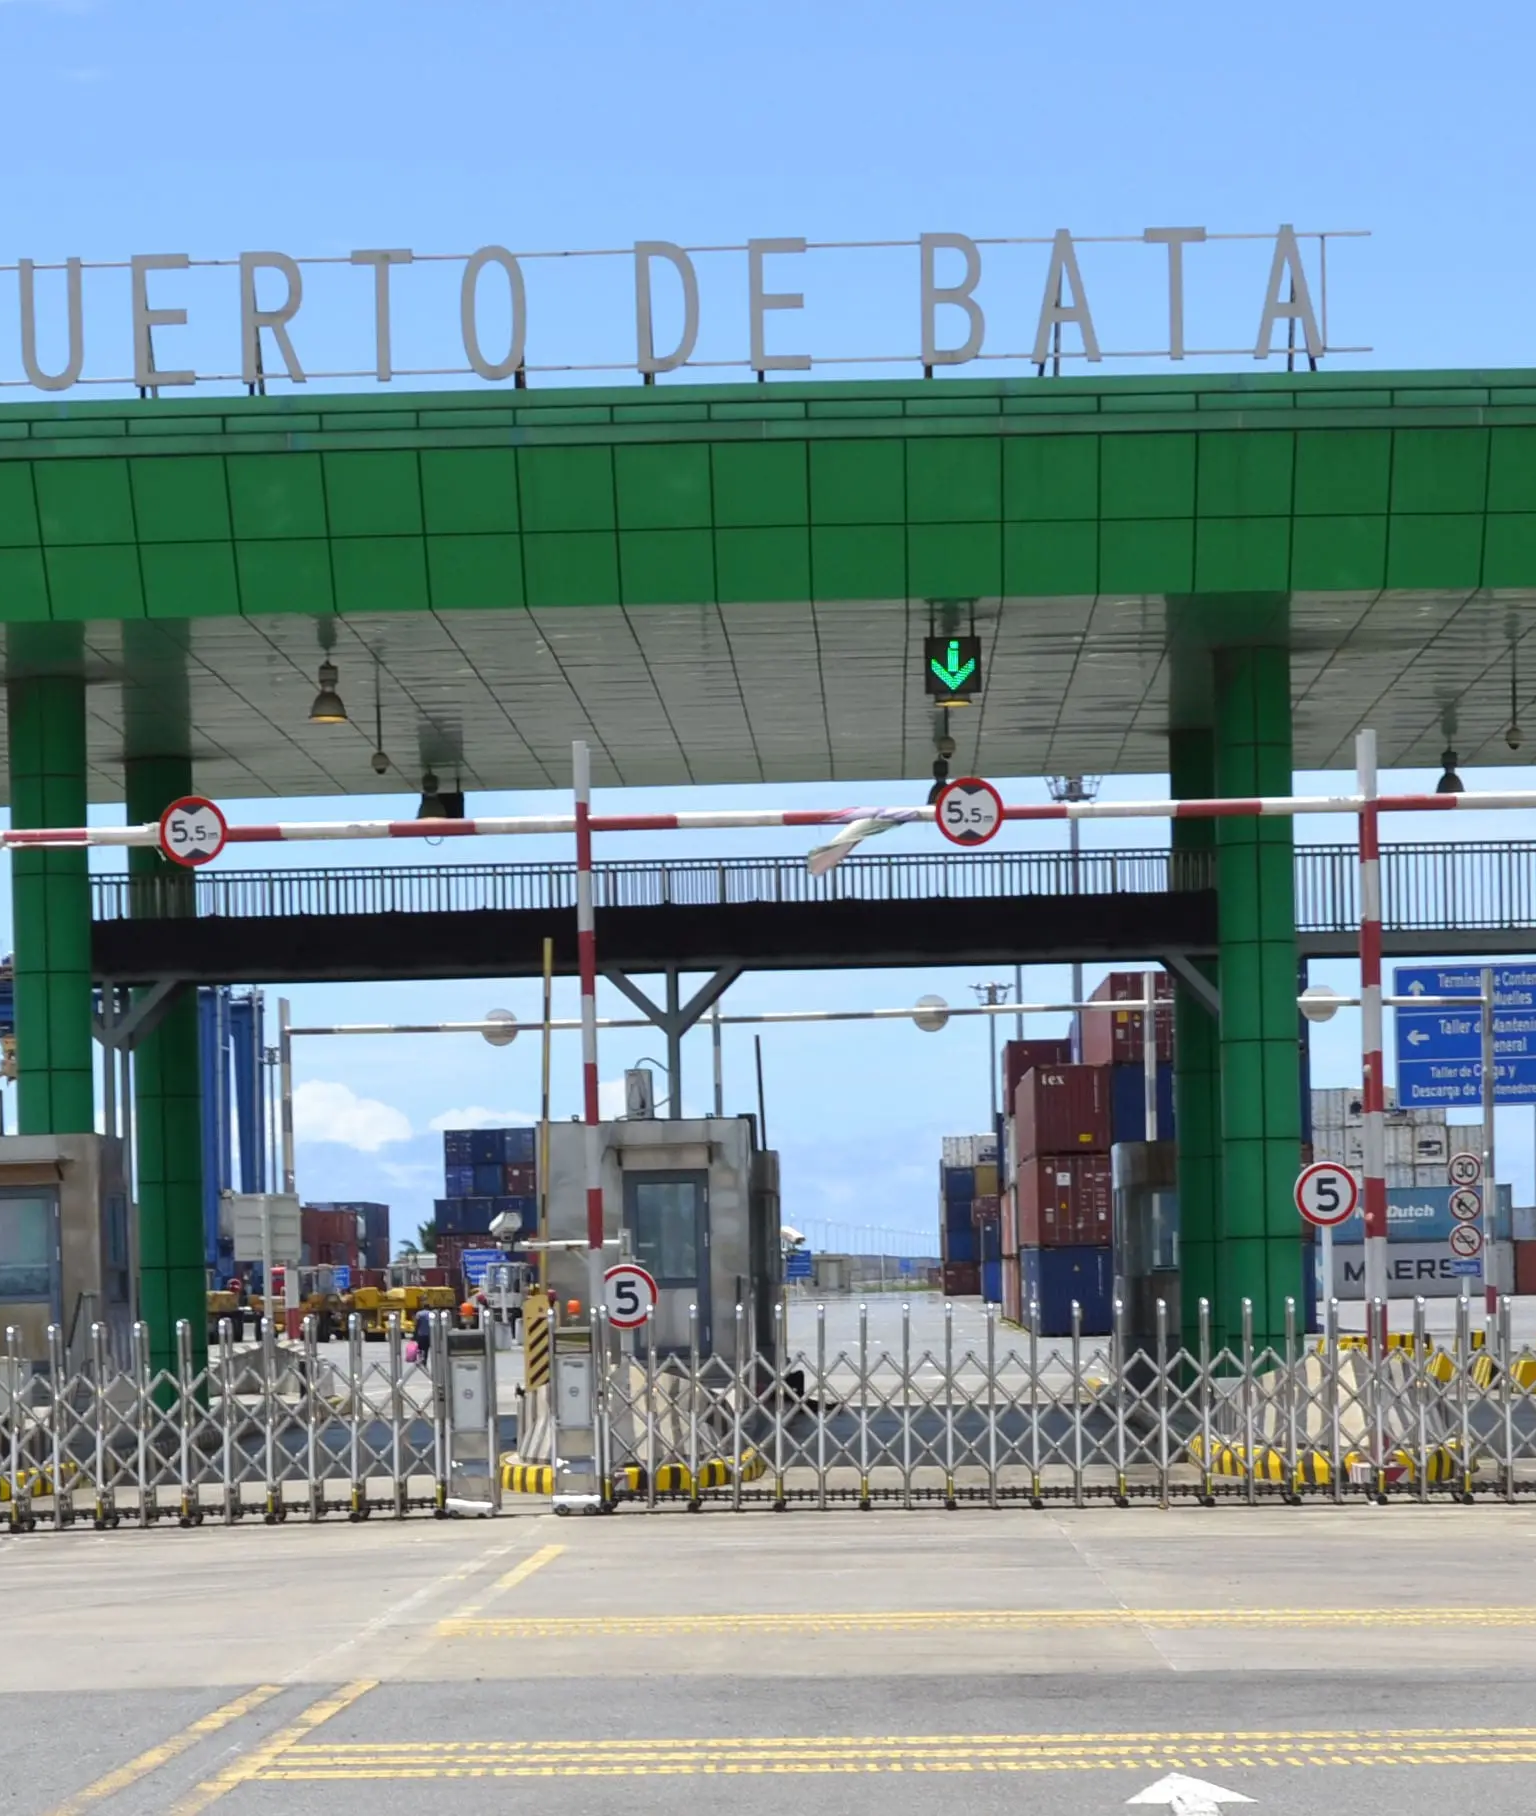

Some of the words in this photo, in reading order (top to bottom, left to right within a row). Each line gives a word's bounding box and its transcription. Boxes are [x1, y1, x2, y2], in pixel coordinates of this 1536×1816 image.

[635, 237, 811, 373] DE
[920, 224, 1325, 365] BATA
[946, 800, 994, 825] 5.5m
[170, 819, 218, 844] 5.5m
[1438, 973, 1482, 988] Termina
[1438, 1019, 1471, 1034] Taller
[1494, 1037, 1528, 1052] eneral
[1041, 1073, 1065, 1086] tex
[1430, 1066, 1458, 1079] Taller
[1459, 1065, 1472, 1077] de
[1509, 1065, 1516, 1079] y
[1412, 1084, 1460, 1100] Descarga
[1463, 1083, 1476, 1097] de
[1456, 1161, 1475, 1179] 30
[1316, 1177, 1340, 1212] 5
[1386, 1204, 1435, 1218] Dutch
[615, 1280, 640, 1316] 5
